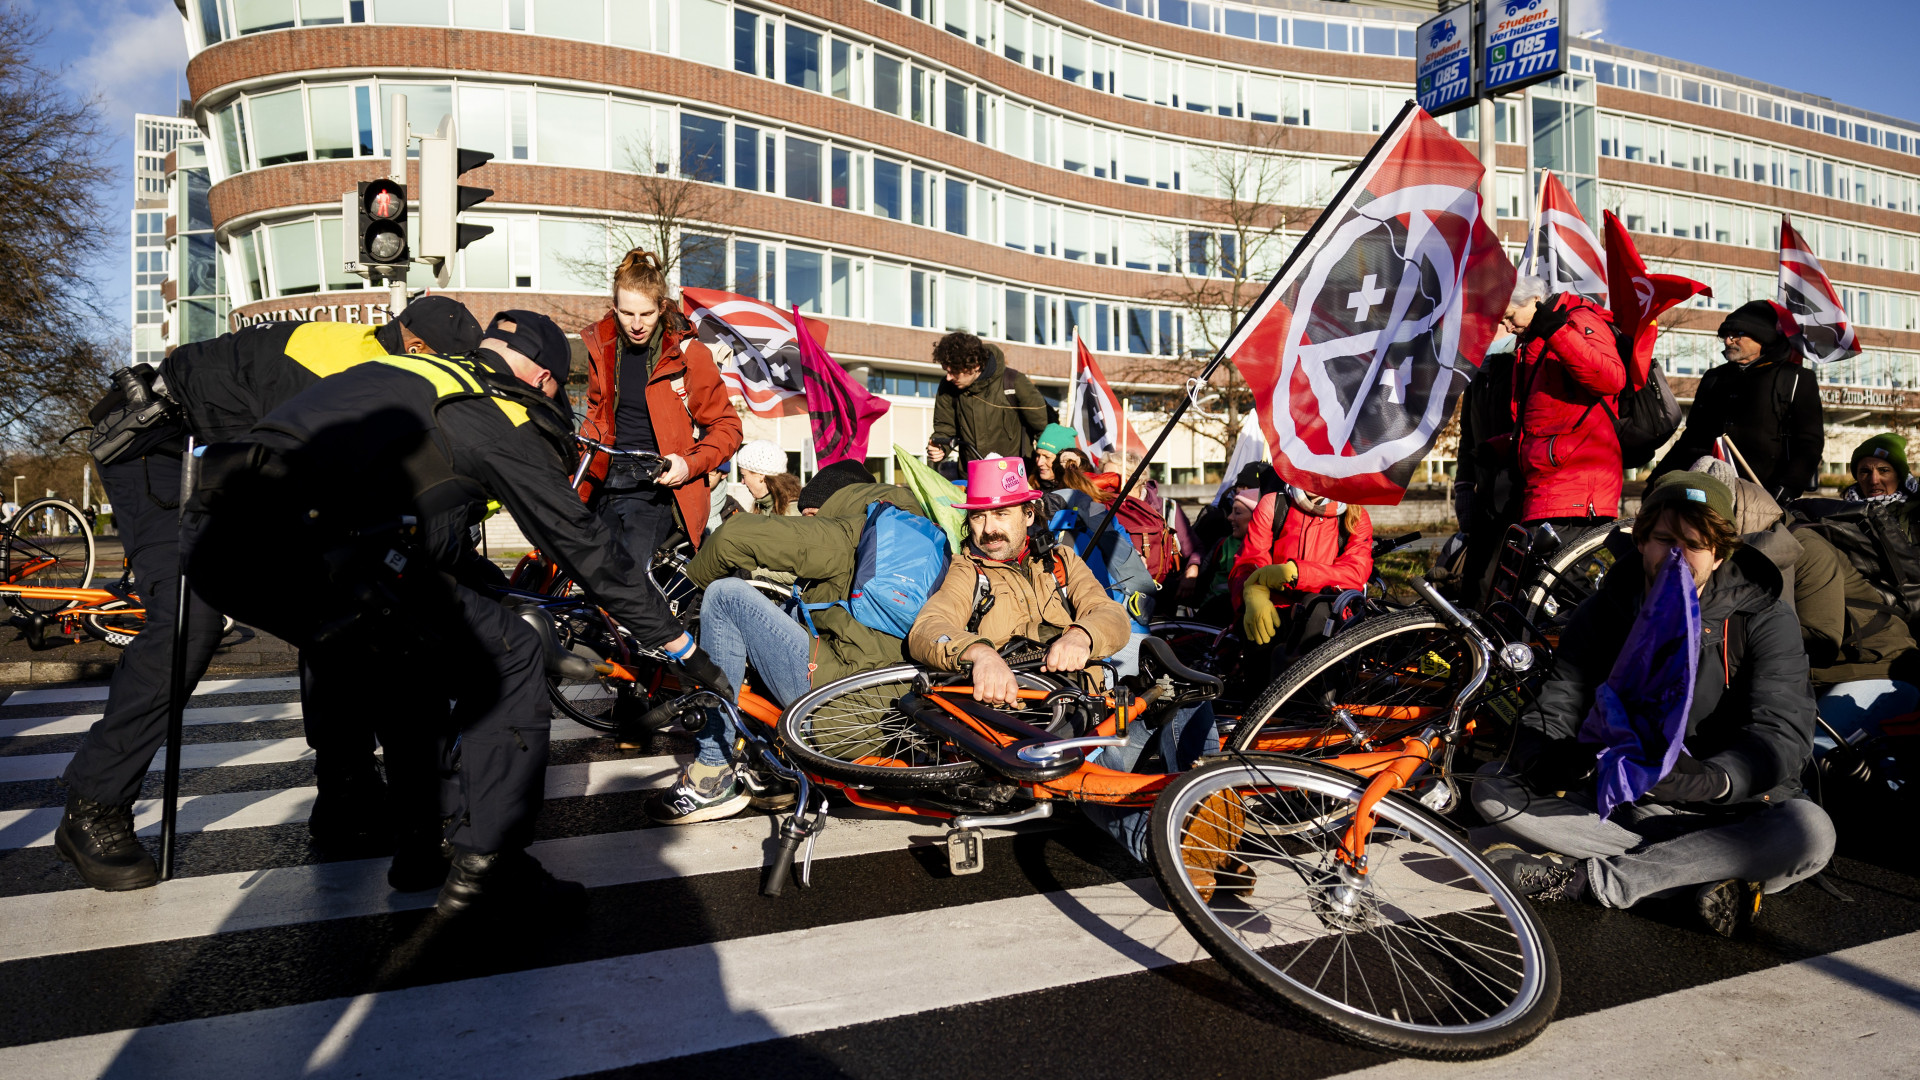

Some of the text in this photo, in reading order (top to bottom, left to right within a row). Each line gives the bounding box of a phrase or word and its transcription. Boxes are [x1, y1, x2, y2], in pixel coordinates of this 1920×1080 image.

[1490, 17, 1557, 44] Verhuizers
[1497, 9, 1548, 33] Student
[1424, 40, 1461, 63] Student
[1512, 33, 1547, 58] 085
[1420, 47, 1468, 74] Verhuizers
[1490, 49, 1557, 84] 777 7777
[1435, 62, 1460, 87] 085
[1419, 77, 1468, 110] 777 7777
[673, 796, 697, 815] N
